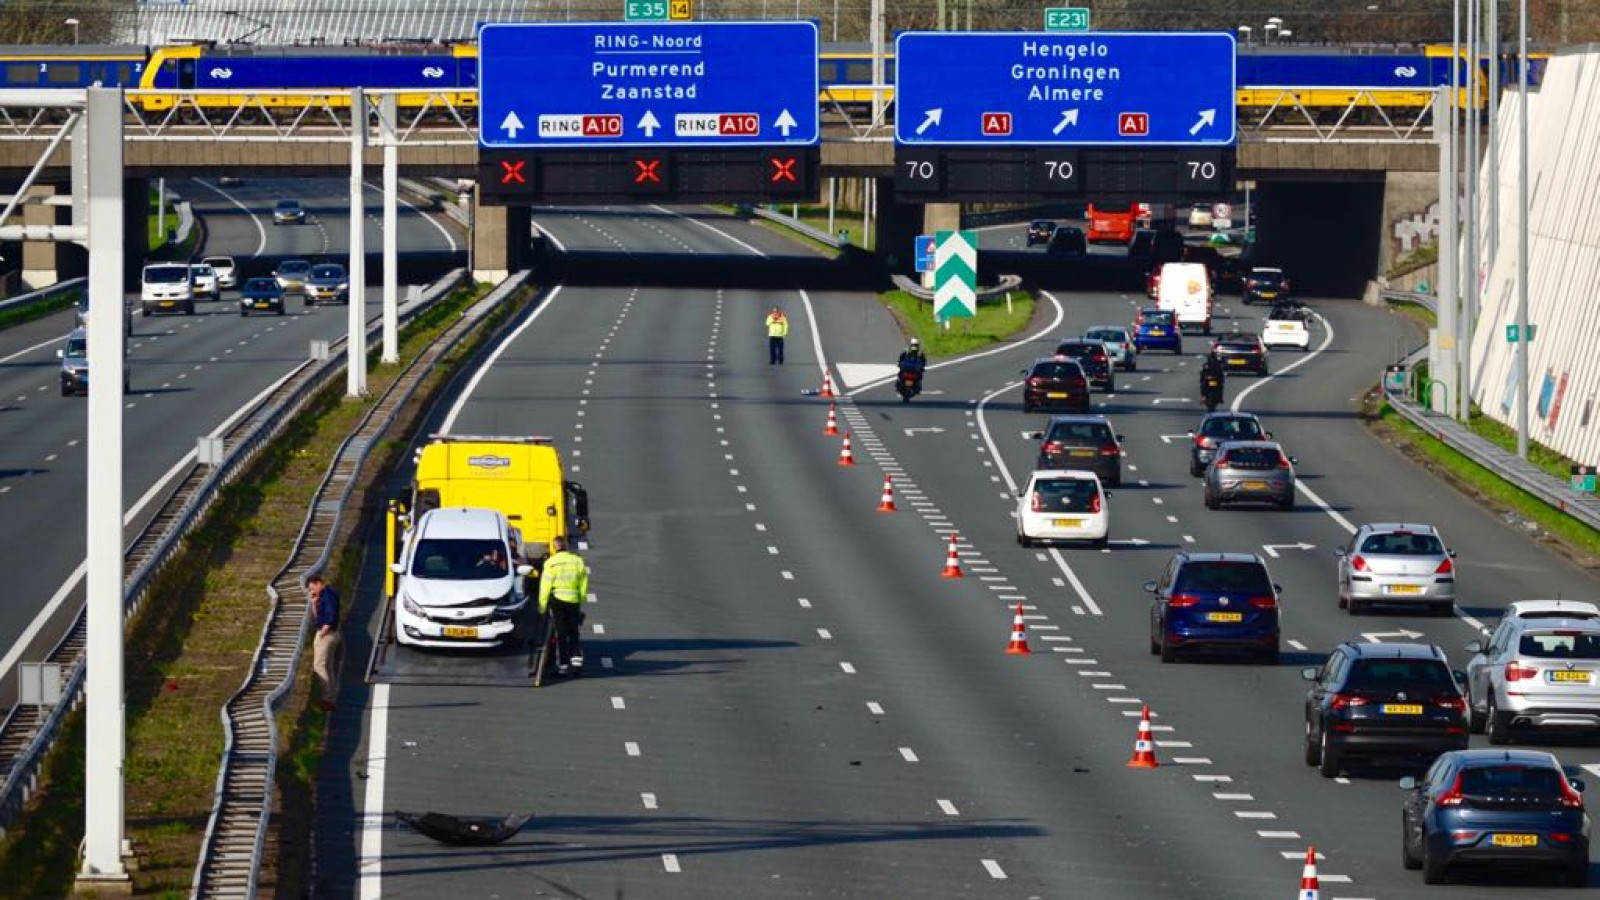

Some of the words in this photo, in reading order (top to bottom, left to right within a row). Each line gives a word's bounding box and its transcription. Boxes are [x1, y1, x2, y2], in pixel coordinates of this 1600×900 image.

[629, 3, 640, 16] E
[642, 3, 665, 16] 35
[672, 3, 688, 16] 14
[1048, 13, 1086, 26] E231
[594, 35, 702, 48] RING-Noord
[1023, 42, 1108, 60] Hengelo
[592, 62, 705, 76] Purmerend
[1011, 65, 1120, 82] Groningen
[601, 84, 697, 99] Zaanstad
[1028, 86, 1103, 100] Almere
[541, 119, 581, 133] RING
[585, 118, 621, 133] A10
[678, 118, 717, 131] RING
[722, 117, 757, 132] A10
[986, 116, 1008, 130] A1
[1123, 116, 1145, 130] A1
[906, 162, 934, 179] 70
[1044, 162, 1073, 179] 70
[1187, 162, 1215, 179] 70
